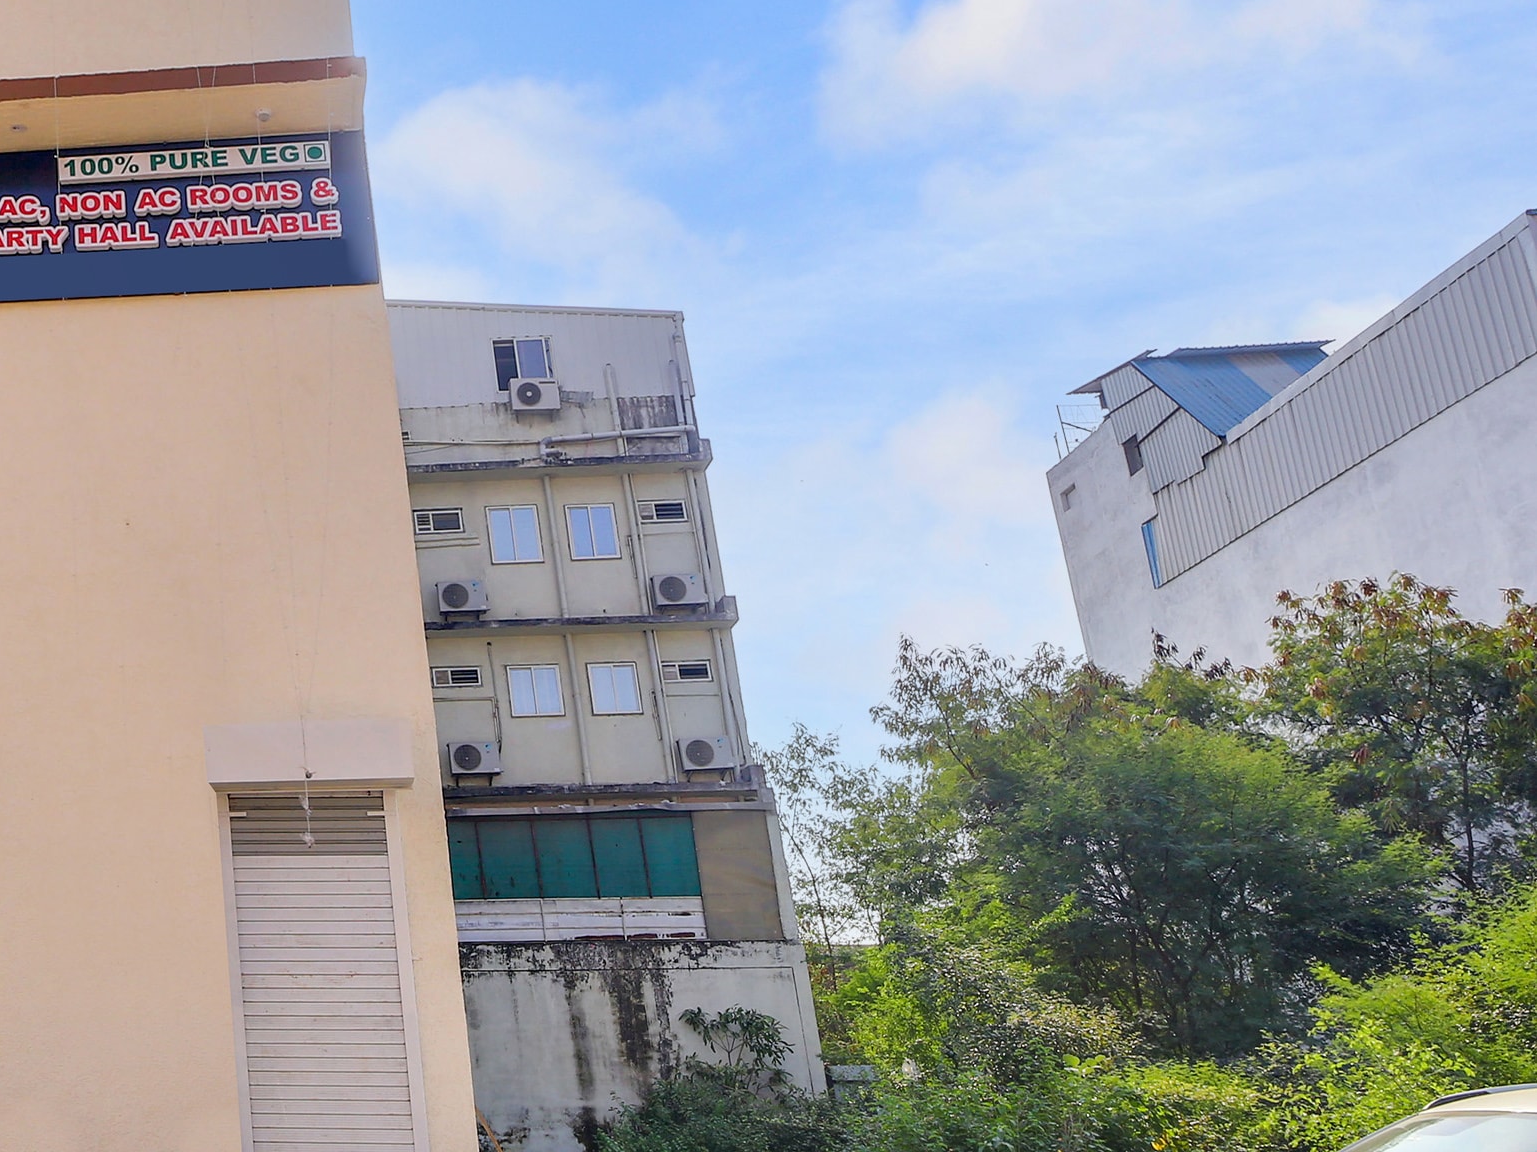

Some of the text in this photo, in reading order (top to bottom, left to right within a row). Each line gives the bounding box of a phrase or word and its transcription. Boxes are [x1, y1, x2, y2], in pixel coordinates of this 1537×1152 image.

[63, 144, 300, 177] 100% PURE VEG
[58, 192, 124, 216] NON
[136, 189, 180, 213] AC
[188, 182, 300, 209] ROOMS
[312, 179, 337, 201] &
[76, 223, 157, 247] HALL
[168, 212, 340, 242] AVAILABLE
